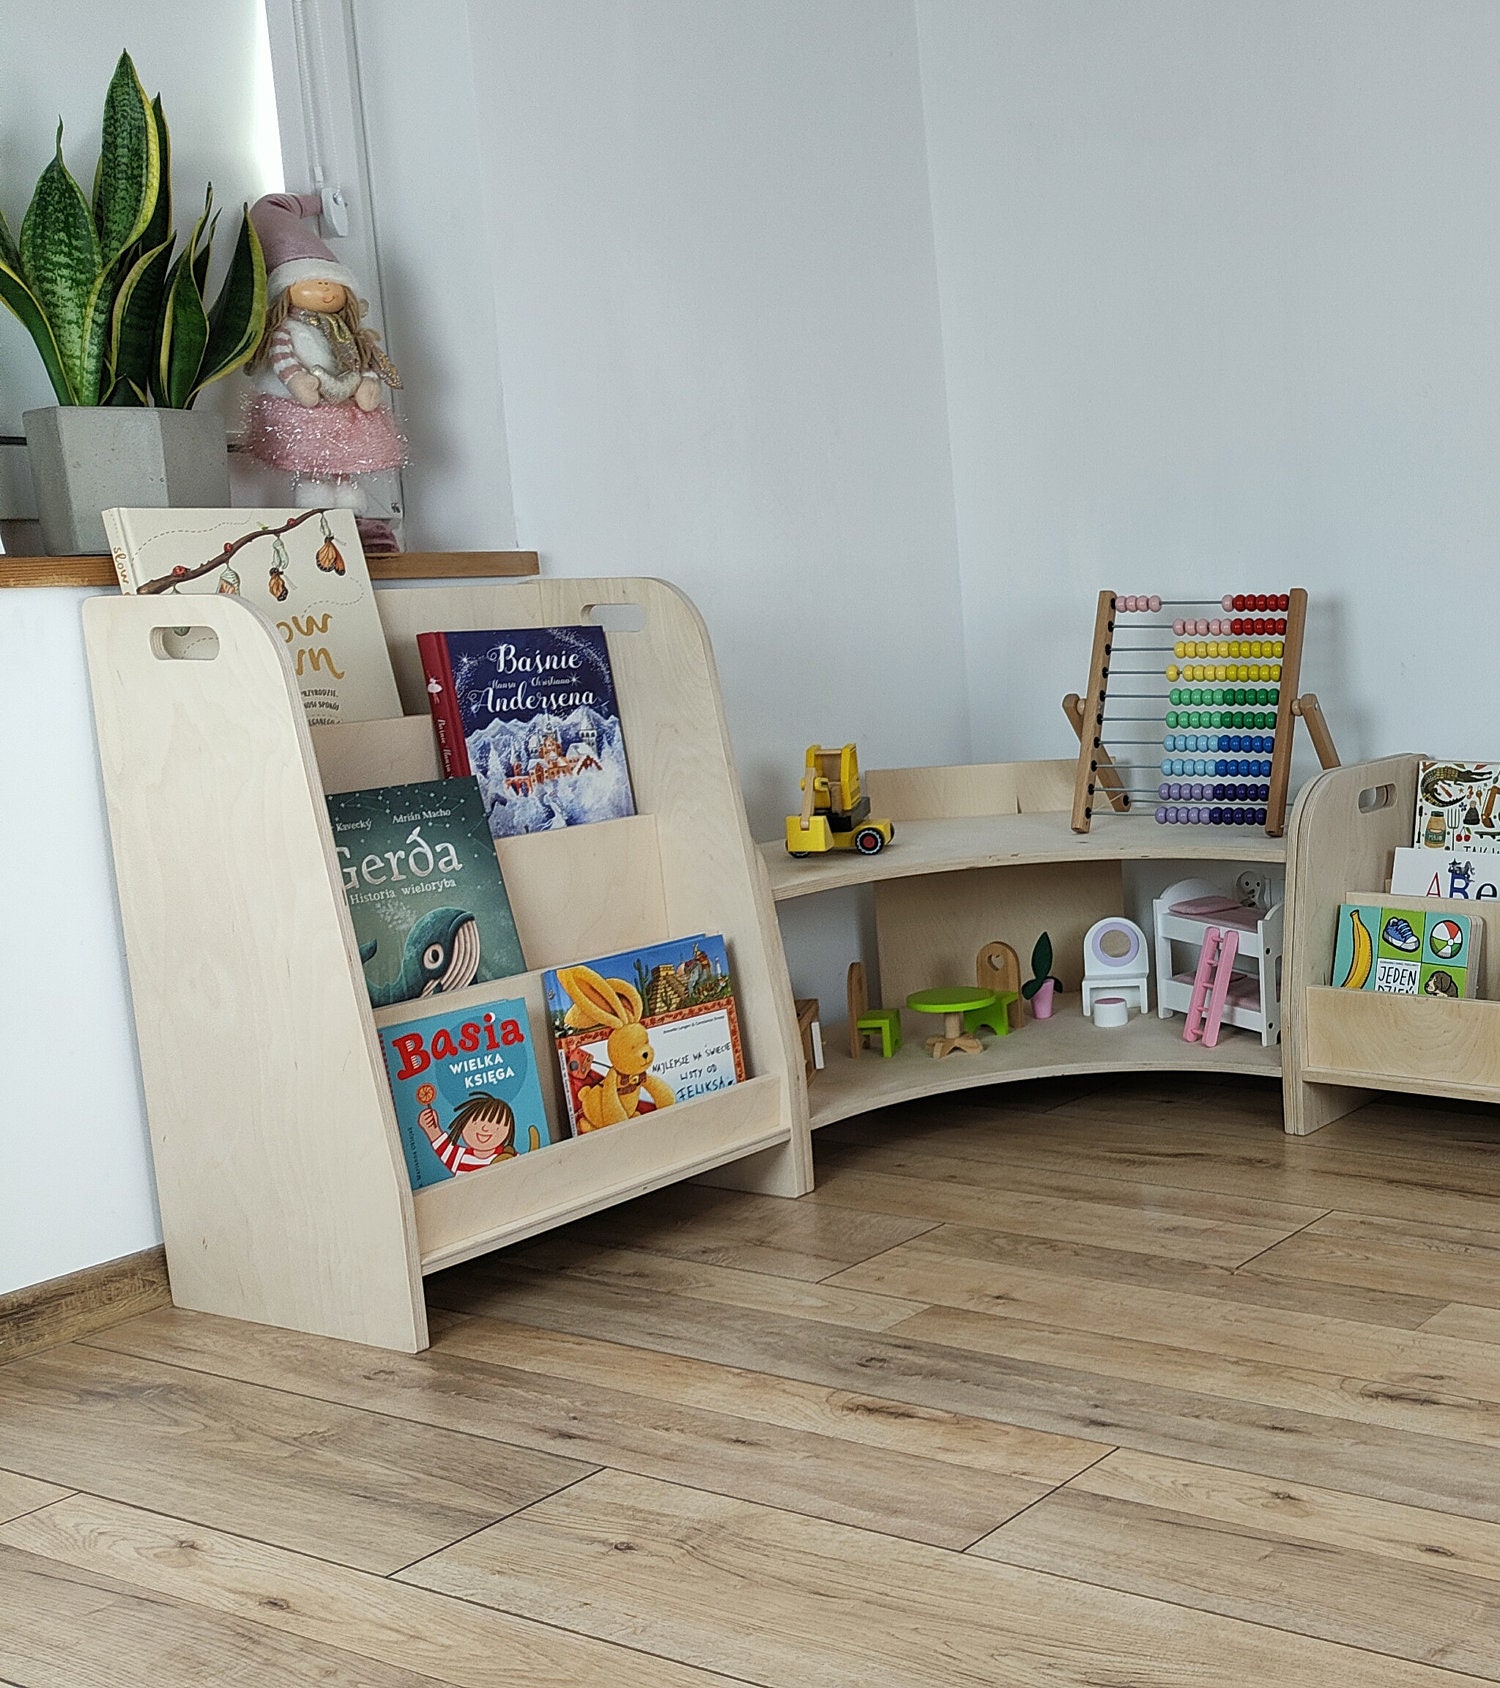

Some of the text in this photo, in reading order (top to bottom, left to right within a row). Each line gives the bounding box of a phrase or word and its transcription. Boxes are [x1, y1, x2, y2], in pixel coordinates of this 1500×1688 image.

[276, 613, 333, 643] ow
[487, 643, 583, 674] Baśnie
[467, 680, 598, 713] Andersena
[392, 813, 421, 824] Adrián
[423, 808, 452, 820] Macho
[335, 826, 463, 890] Gerda
[349, 878, 457, 905] Historia wieloryba
[1378, 966, 1417, 986] JEDEN
[392, 1012, 525, 1081] Basia
[449, 1053, 504, 1075] WIELKA
[680, 1063, 718, 1081] LISTY OD
[464, 1066, 515, 1089] KSIĘGA
[675, 1076, 726, 1101] FELIKSA
